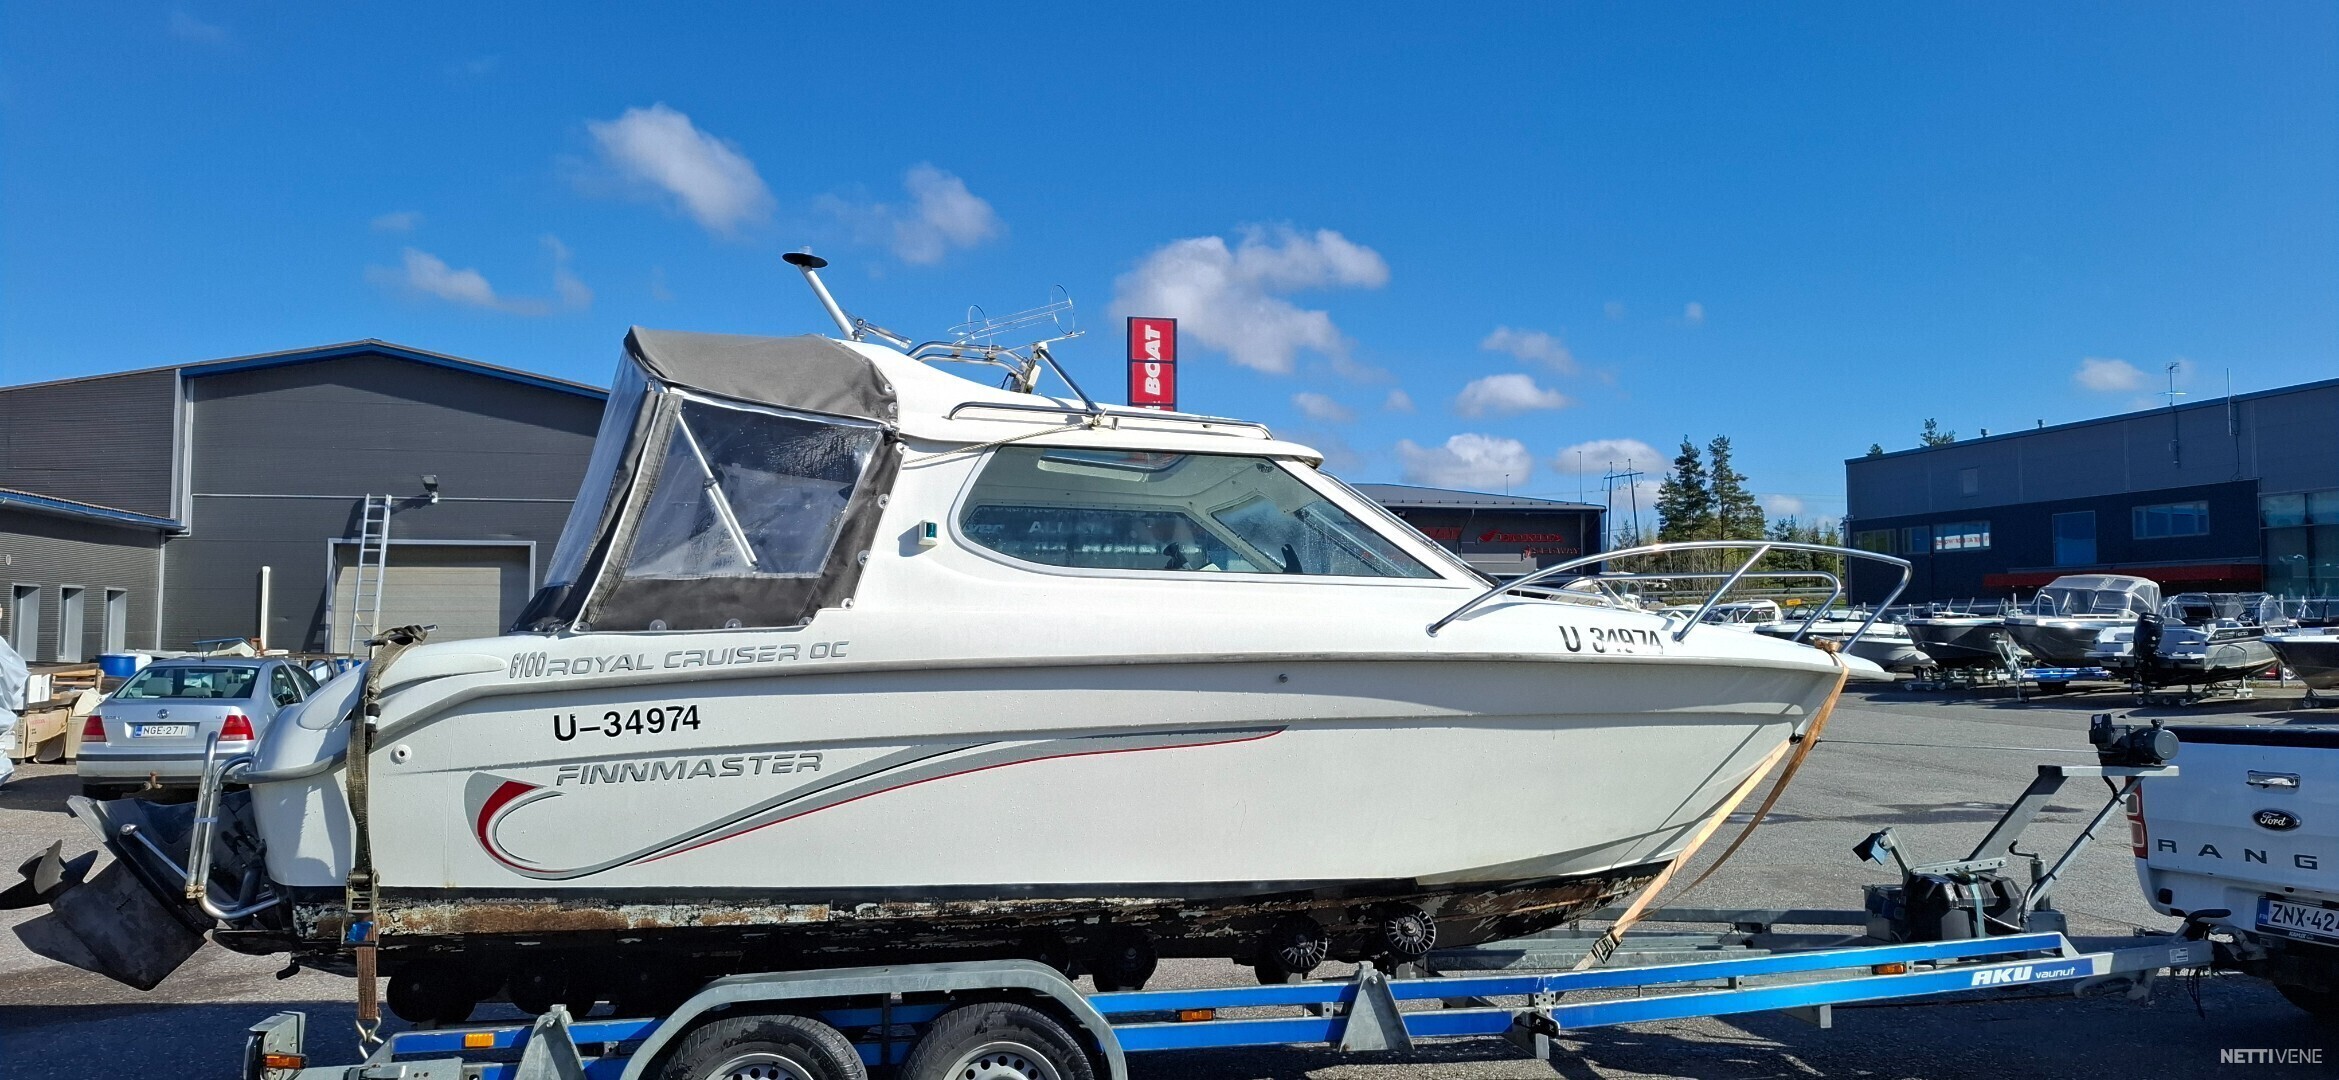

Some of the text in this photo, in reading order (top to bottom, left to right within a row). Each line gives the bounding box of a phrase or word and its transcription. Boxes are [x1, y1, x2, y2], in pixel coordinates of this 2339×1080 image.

[1144, 324, 1160, 395] BOAT
[509, 651, 547, 679] 6100
[547, 653, 654, 677] ROYAL
[663, 644, 801, 669] CRUISER
[553, 705, 701, 742] U-34974
[556, 752, 823, 786] FINNMASTER
[2259, 811, 2287, 826] Ford
[2157, 838, 2318, 870] RANG
[2271, 903, 2339, 932] ZNX-42
[1971, 966, 2076, 986] AKU vaunut
